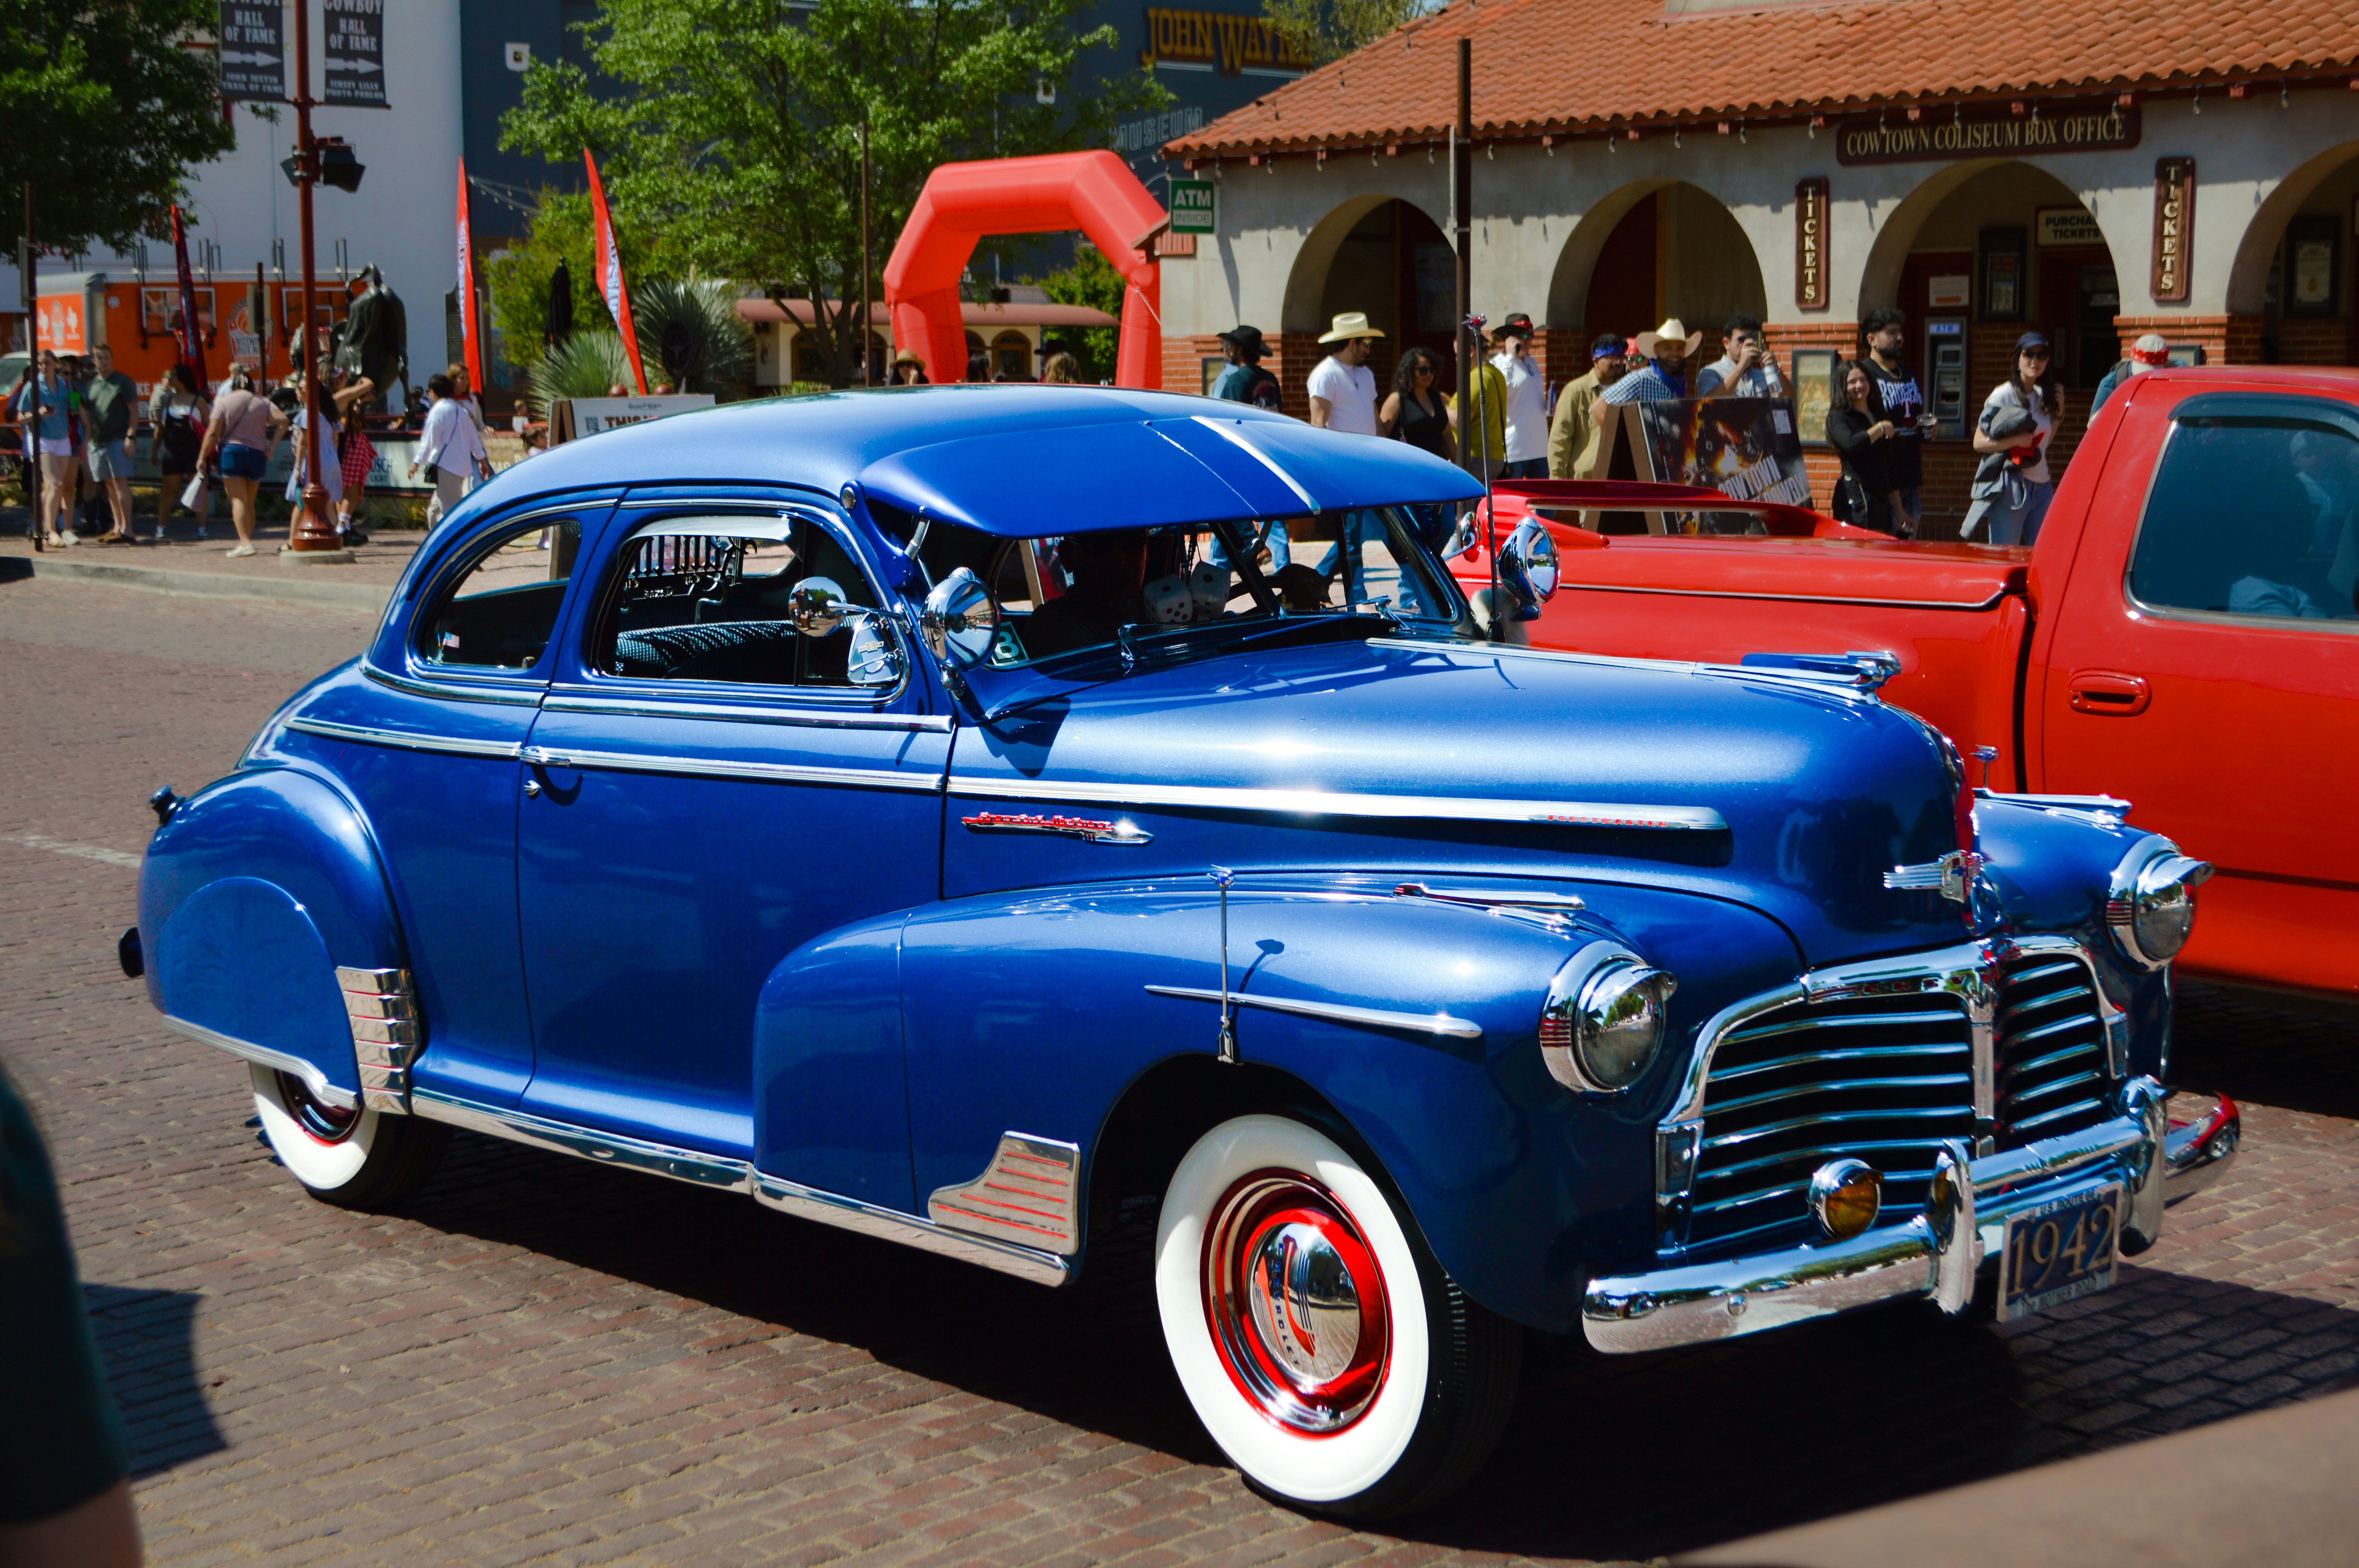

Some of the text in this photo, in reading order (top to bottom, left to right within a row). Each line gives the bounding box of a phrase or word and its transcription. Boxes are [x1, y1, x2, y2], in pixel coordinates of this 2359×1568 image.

[236, 9, 265, 27] HALL
[339, 18, 367, 35] HALL
[225, 25, 276, 44] OF FAME
[329, 33, 377, 52] OF FAME
[1142, 7, 1214, 68] JOHN
[262, 85, 284, 94] FAME
[326, 89, 384, 100] PHOTO PARLOR
[1111, 107, 1203, 151] MUSEUM
[1846, 114, 2125, 156] COWTOWN COLISEUM BOX OFFICE
[1174, 189, 1211, 207] ATM
[1176, 214, 1210, 223] INSIDE
[2161, 165, 2179, 290] TICKETS
[1804, 186, 1816, 300] TICKETS
[2052, 228, 2100, 239] TICKETS
[1936, 325, 1954, 333] ATM
[1901, 399, 1912, 418] T
[1548, 815, 1667, 828] FLEETMASTER
[2007, 1204, 2114, 1296] 1942
[1272, 1243, 1300, 1367] CHEVROLET
